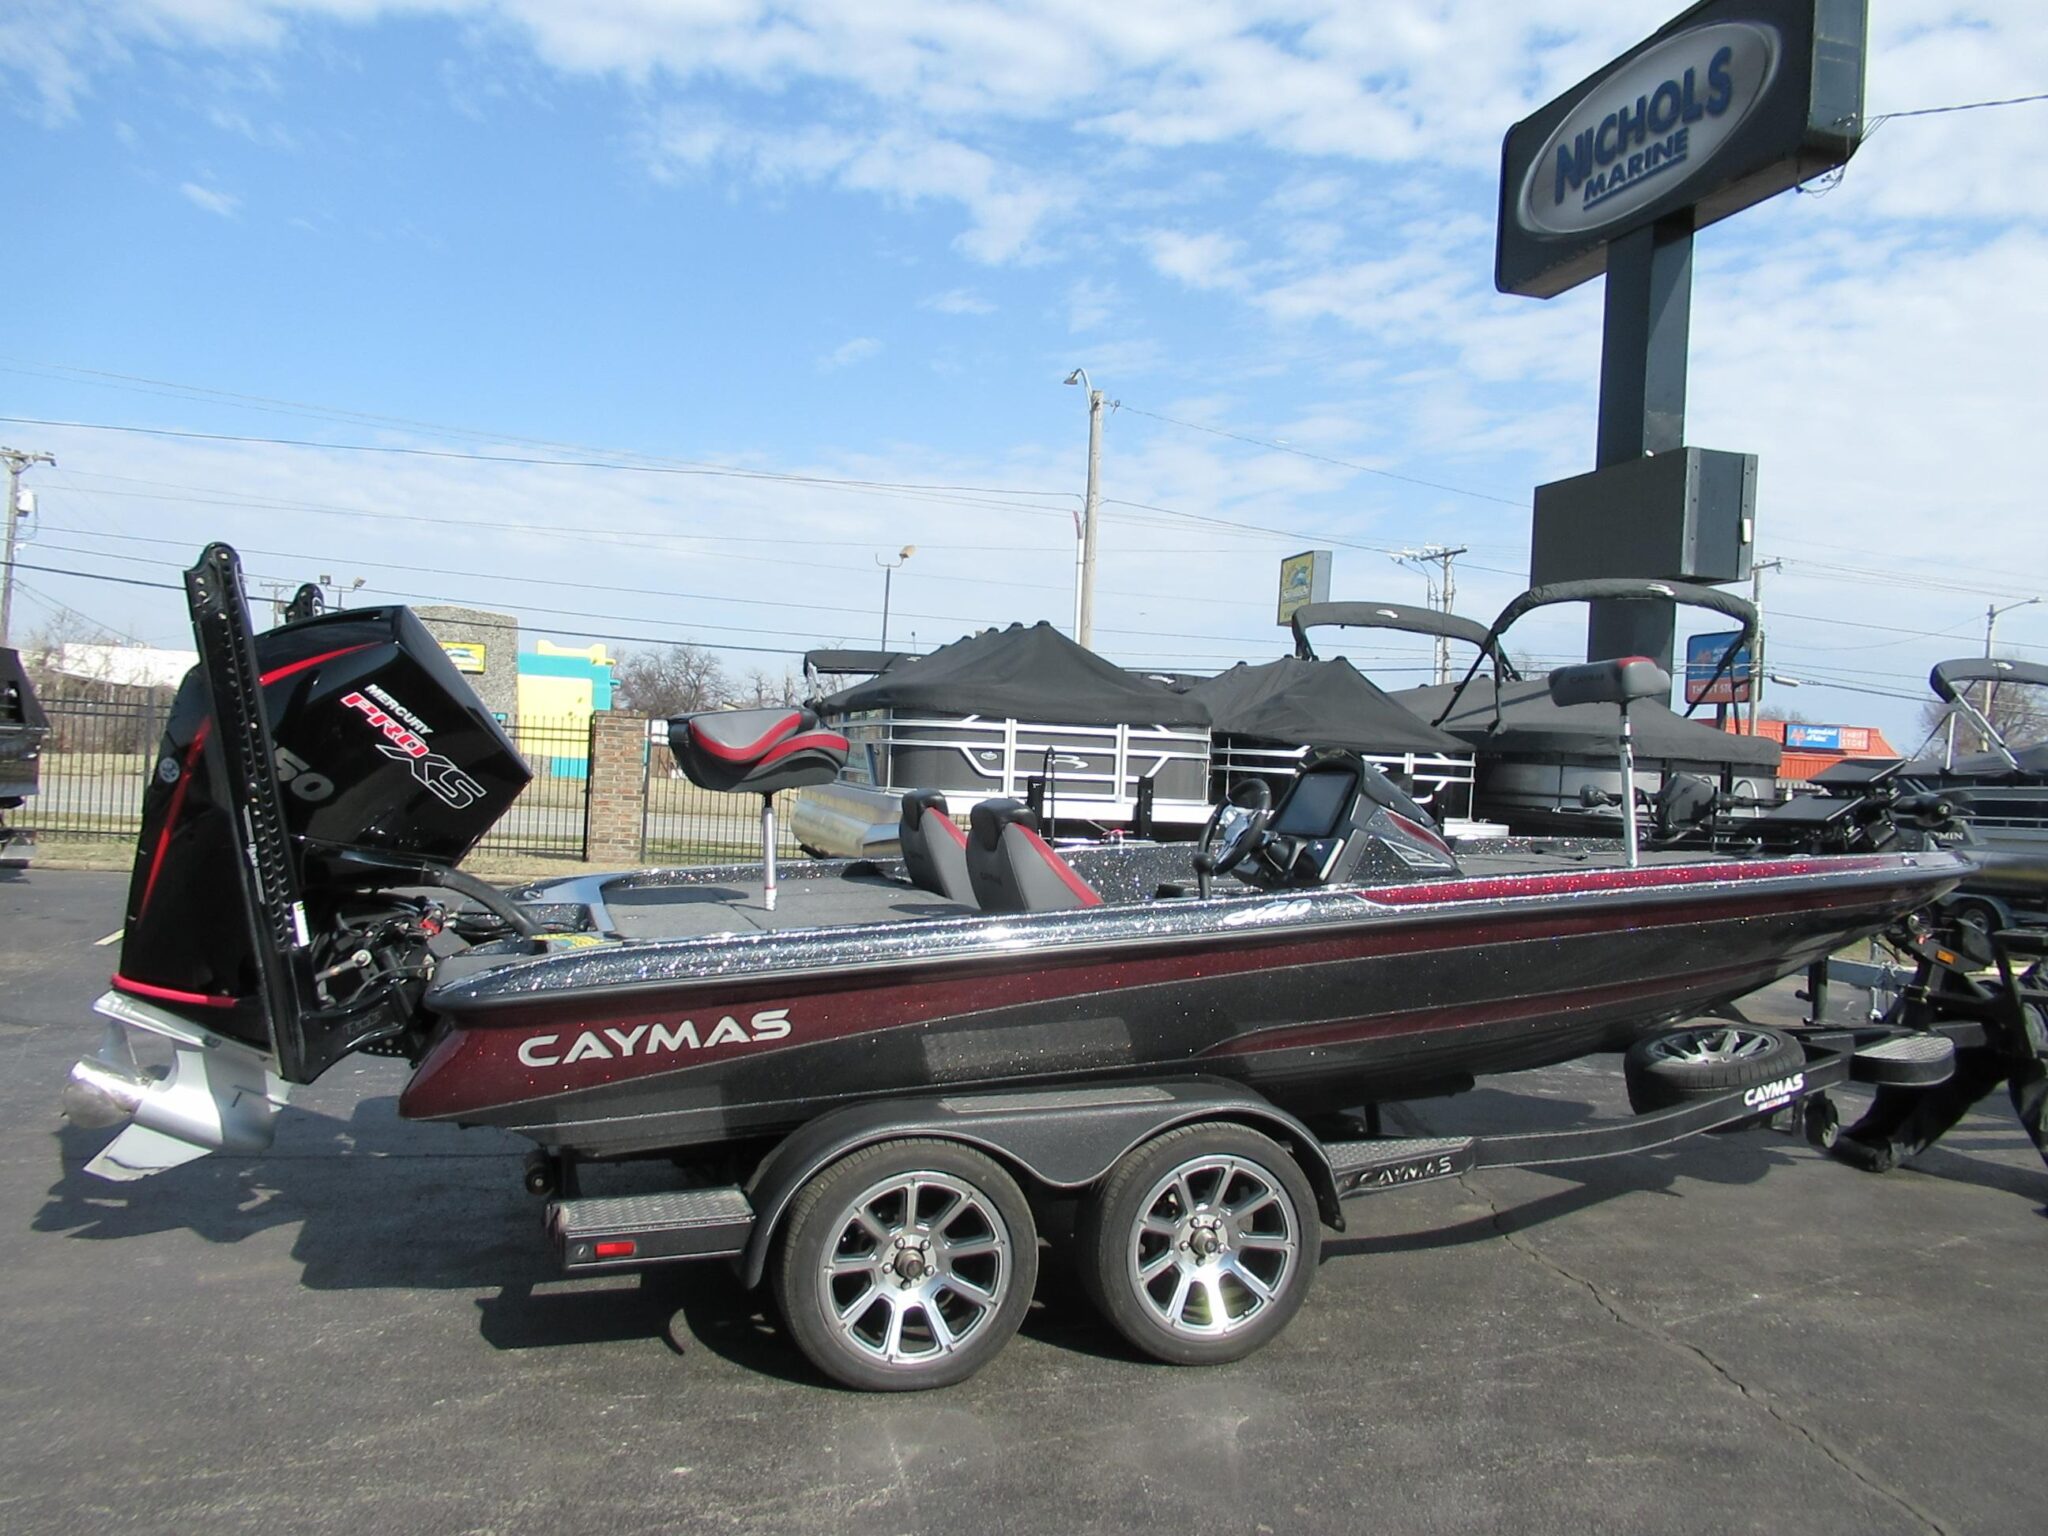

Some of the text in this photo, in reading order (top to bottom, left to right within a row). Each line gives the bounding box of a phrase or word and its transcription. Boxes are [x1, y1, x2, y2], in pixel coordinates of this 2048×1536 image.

[1555, 46, 1733, 206] NICHOLS
[1584, 127, 1690, 202] MARINE
[340, 691, 430, 758] PRO
[364, 683, 433, 735] MERCURY
[1841, 730, 1868, 739] THRIFT
[272, 740, 334, 802] 50
[1841, 739, 1868, 749] STORE
[375, 743, 487, 809] XS
[1935, 832, 1964, 841] MIN
[518, 1009, 792, 1068] CAYMAS
[1744, 1073, 1804, 1106] CAYMAS
